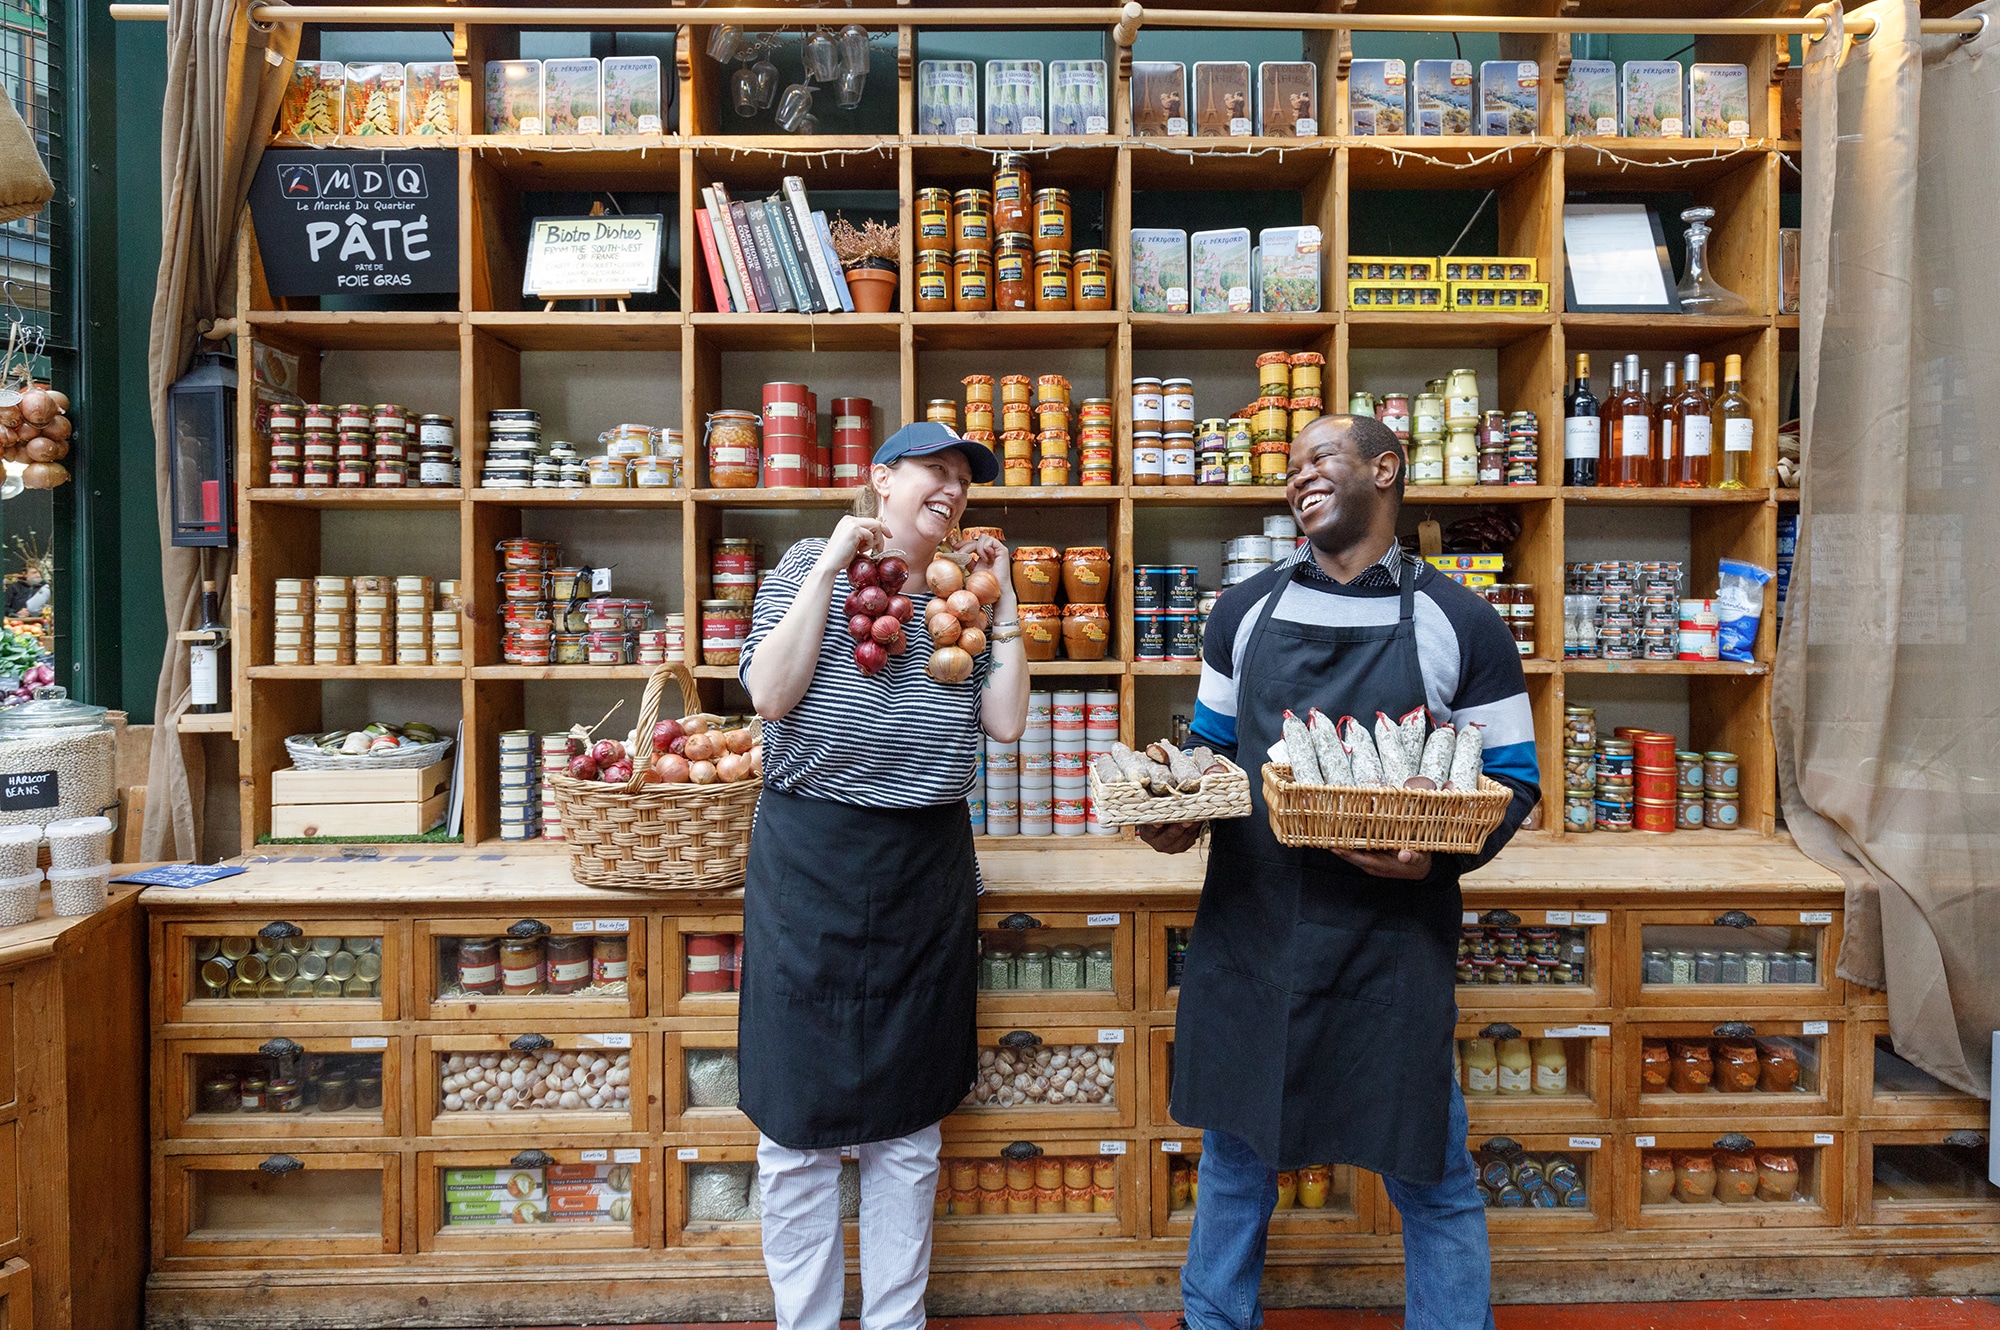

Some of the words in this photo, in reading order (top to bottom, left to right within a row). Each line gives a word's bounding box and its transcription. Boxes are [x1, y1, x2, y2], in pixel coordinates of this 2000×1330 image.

[323, 170, 351, 195] M
[363, 171, 383, 193] D
[397, 168, 421, 194] Q
[297, 201, 309, 211] Le
[314, 201, 351, 211] Marché
[355, 201, 369, 210] Du
[374, 201, 416, 210] Quartier
[771, 205, 780, 217] THE
[785, 209, 796, 226] YEAR
[722, 212, 732, 226] 500
[774, 216, 788, 243] BOROUGH
[791, 224, 798, 232] IN
[306, 212, 432, 262] PÂTÉ
[545, 225, 591, 244] Bistro
[593, 222, 642, 241] Dishes
[792, 231, 804, 253] CHEESE
[544, 246, 569, 255] FROM
[571, 245, 586, 253] THE
[591, 243, 643, 253] SOUTH-WEST
[726, 225, 746, 271] SENSATIONAL
[736, 224, 748, 247] COOK
[743, 247, 755, 269] BOOK
[742, 223, 762, 272] FARMHOUSE
[754, 225, 767, 247] MEAT
[761, 247, 774, 270] BOOK
[761, 223, 776, 252] GINGER
[770, 251, 781, 268] PIG
[783, 242, 796, 266] MARKET
[337, 275, 370, 288] FOIE
[373, 274, 412, 287] GRAS
[739, 270, 754, 297] SALADS
[790, 266, 805, 298] COOKBOOK
[8, 773, 50, 785] HARICOT
[5, 785, 40, 798] BEANS
